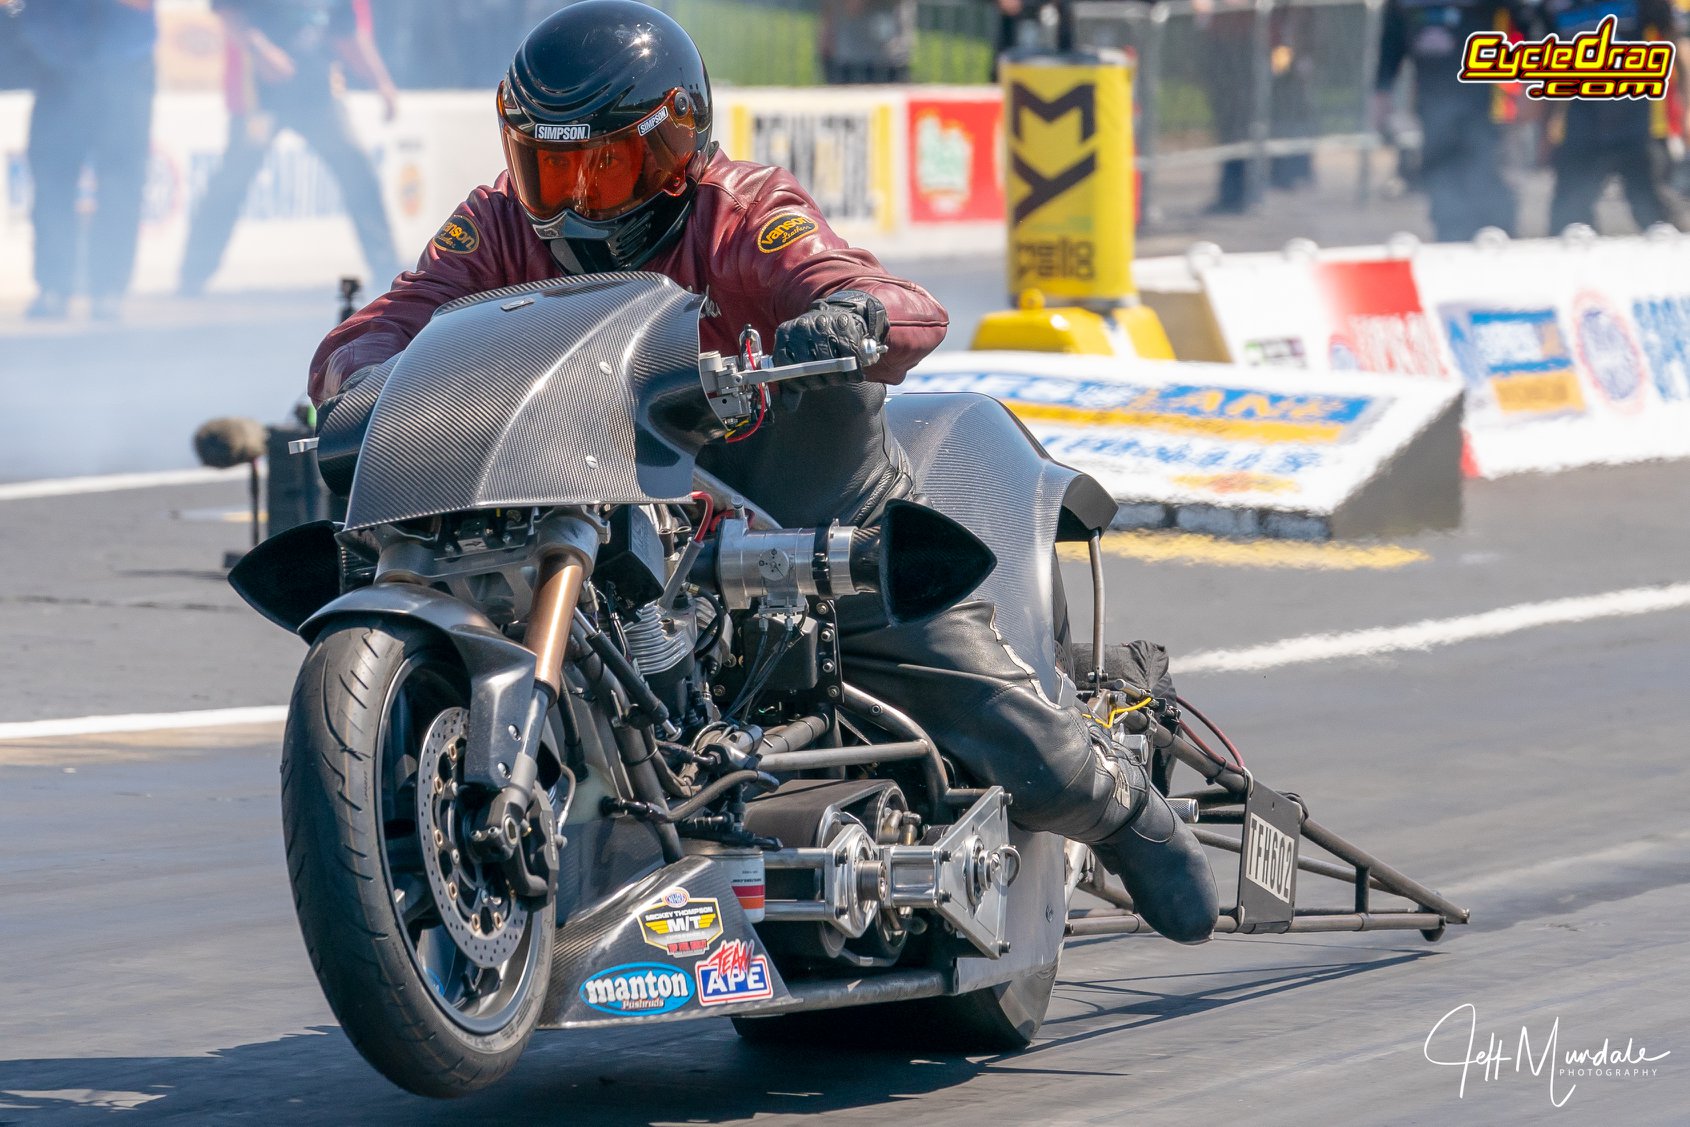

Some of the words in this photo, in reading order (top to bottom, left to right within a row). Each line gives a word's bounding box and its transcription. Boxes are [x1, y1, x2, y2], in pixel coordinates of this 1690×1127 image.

[645, 911, 674, 921] MICKEY
[673, 906, 713, 917] THOMPSON
[666, 916, 702, 933] M/T
[709, 943, 754, 979] TEAM
[586, 970, 689, 1004] manton
[706, 966, 765, 994] APE
